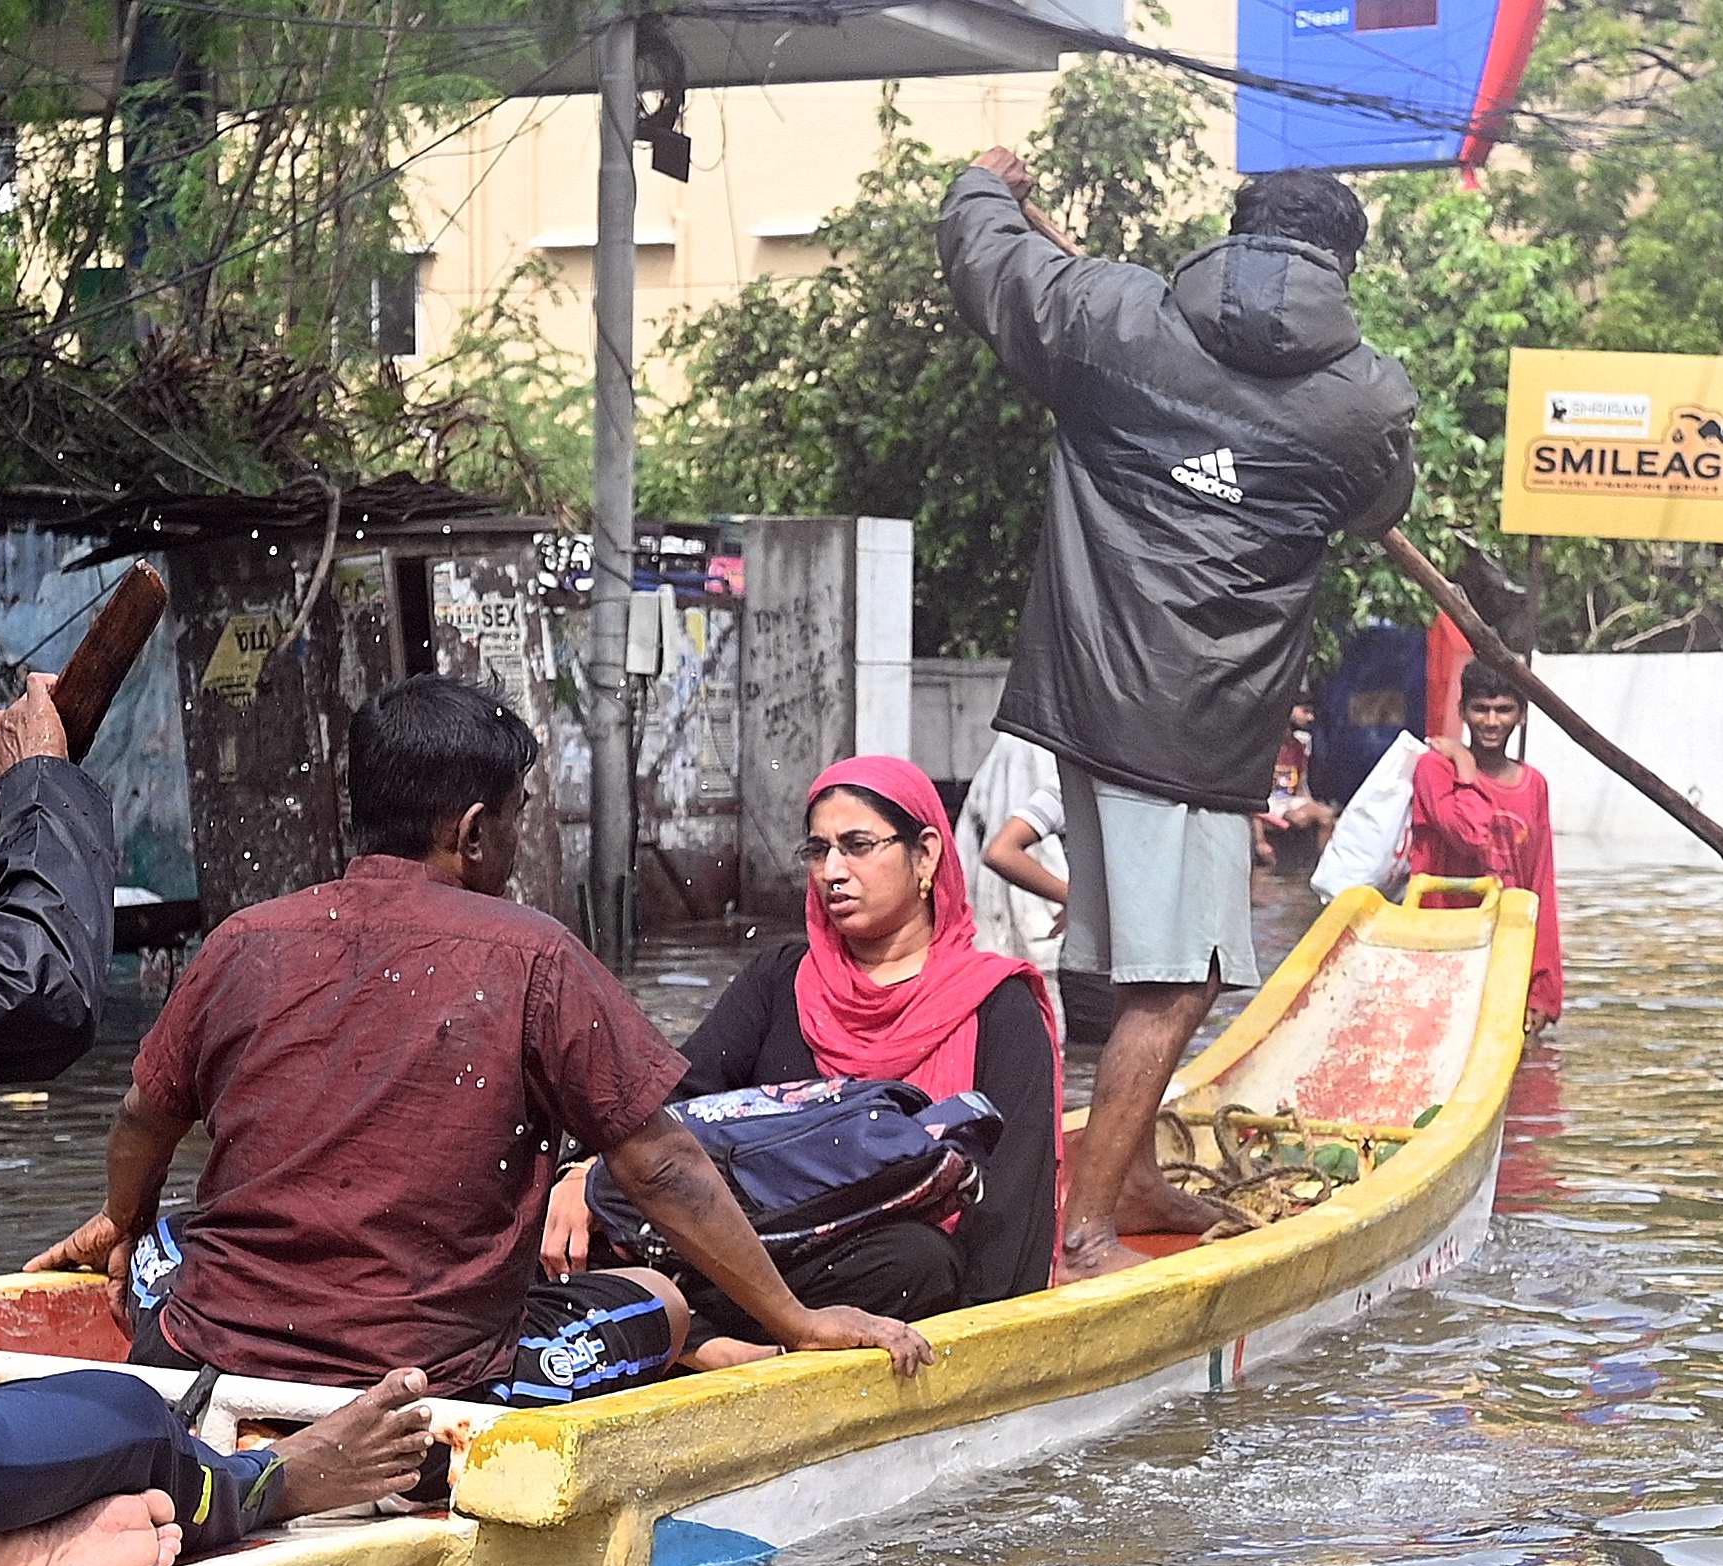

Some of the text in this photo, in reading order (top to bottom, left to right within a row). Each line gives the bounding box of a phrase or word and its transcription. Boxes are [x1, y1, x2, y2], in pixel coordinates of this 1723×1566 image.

[1295, 7, 1350, 29] Diesel
[1171, 465, 1243, 504] adidas
[481, 601, 519, 628] SEX
